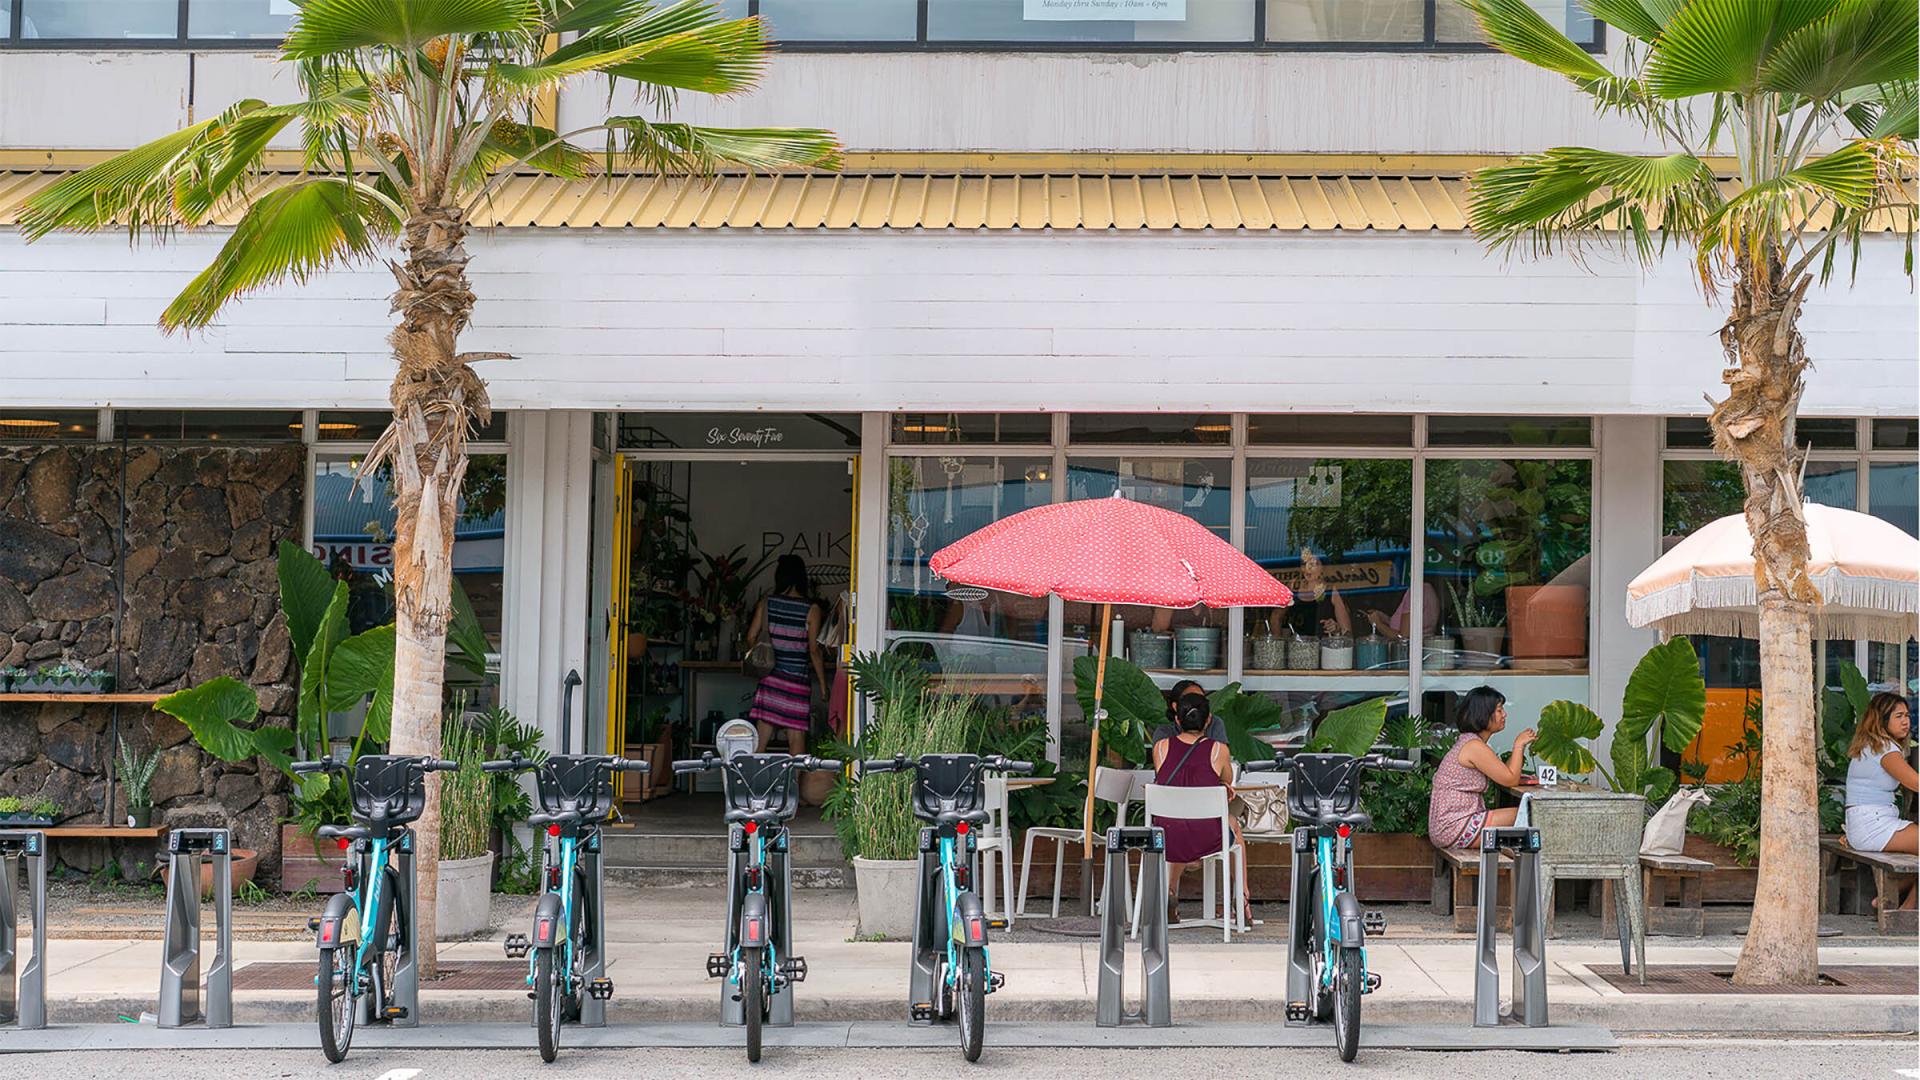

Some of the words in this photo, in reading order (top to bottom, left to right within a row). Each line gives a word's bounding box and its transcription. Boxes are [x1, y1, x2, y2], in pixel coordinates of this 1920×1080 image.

[1042, 0, 1073, 9] Monday
[1090, 0, 1119, 9] Sunday
[1151, 0, 1168, 9] 6pm
[706, 427, 727, 444] Six
[728, 427, 764, 448] Seventy
[765, 427, 784, 444] Five
[1541, 768, 1555, 782] 42
